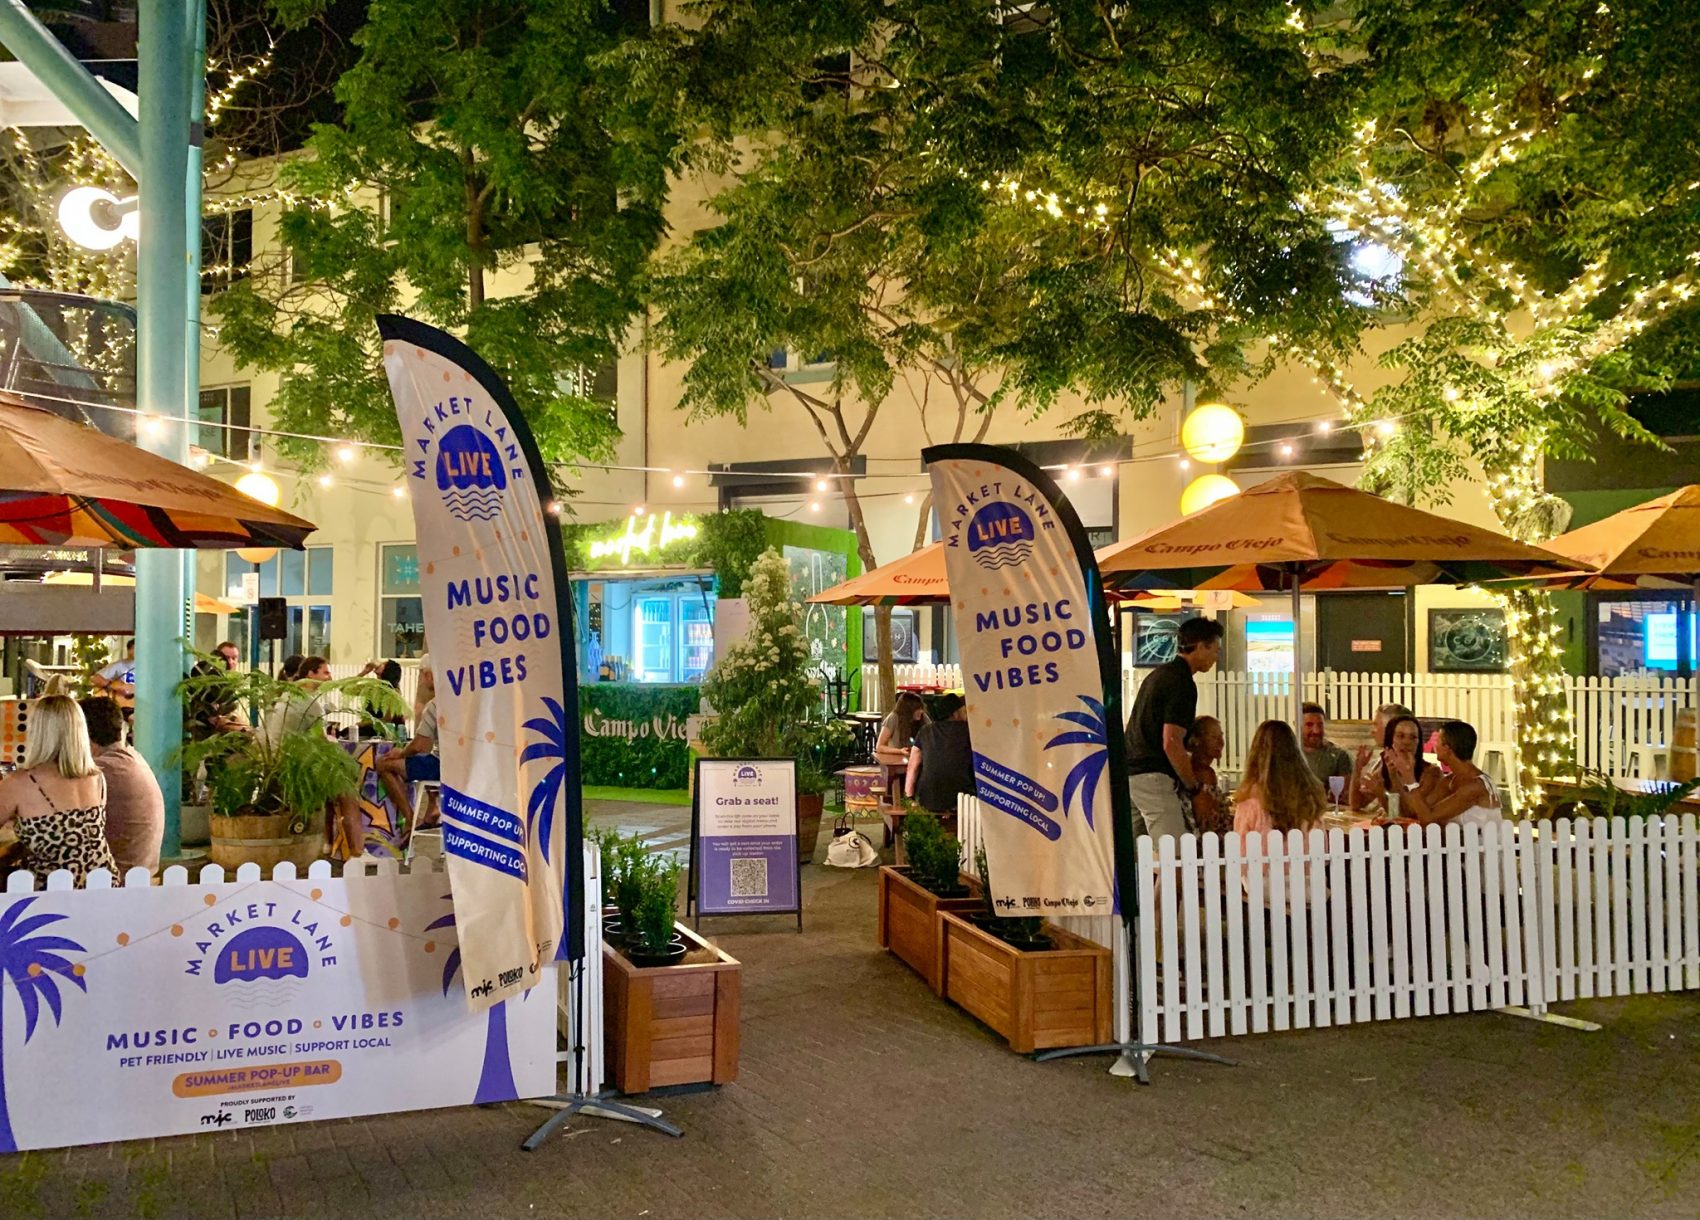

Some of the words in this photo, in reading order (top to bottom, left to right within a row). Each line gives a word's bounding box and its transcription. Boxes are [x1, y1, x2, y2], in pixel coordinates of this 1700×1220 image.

[412, 397, 472, 480] MARKET
[485, 410, 525, 480] LANE
[443, 452, 493, 477] LIVE
[948, 482, 1002, 548] MARKET
[1014, 485, 1055, 531] LANE
[976, 516, 1023, 542] LIVE
[1144, 542, 1222, 555] Campo
[447, 573, 539, 610] MUSIC
[893, 574, 944, 586] Campo
[473, 613, 551, 648] FOOD
[976, 599, 1073, 633] MUSIC
[1000, 628, 1086, 659] FOOD
[446, 654, 528, 697] VIBES
[973, 662, 1060, 692] VIBES
[584, 707, 650, 746] Campo
[652, 712, 690, 749] Vie
[980, 761, 1016, 785] SUMMER
[1016, 779, 1034, 793] POP
[1034, 789, 1046, 803] UP!
[447, 796, 490, 823] SUMMER
[491, 815, 512, 831] POP
[715, 797, 742, 806] Grab
[753, 796, 779, 806] seat!
[979, 786, 1029, 816] SUPPORTING
[1029, 812, 1050, 833] LOCAL
[446, 832, 507, 865] SUPPORTING
[508, 857, 527, 873] LOC
[184, 902, 277, 976] MARKET
[290, 909, 337, 968] LANE
[230, 946, 294, 972] LIVE
[470, 978, 493, 999] mjc
[106, 1027, 198, 1052] MUSIC
[228, 1018, 303, 1041] FOOD
[331, 1011, 405, 1031] VIBES
[119, 1055, 143, 1068] PET
[146, 1050, 208, 1066] FRIENDLY
[216, 1048, 244, 1060] LIVE
[246, 1044, 287, 1057] MUSIC
[294, 1039, 350, 1053] SUPPORT
[353, 1037, 392, 1050] LOCAL
[184, 1071, 246, 1088] SUMMER
[250, 1066, 301, 1081] POP-UP
[304, 1063, 331, 1076] BAR
[200, 1109, 232, 1127] mjc
[244, 1107, 276, 1122] POLOKO
[220, 1099, 250, 1108] PROUDLY
[250, 1095, 287, 1105] SUPPORTED
